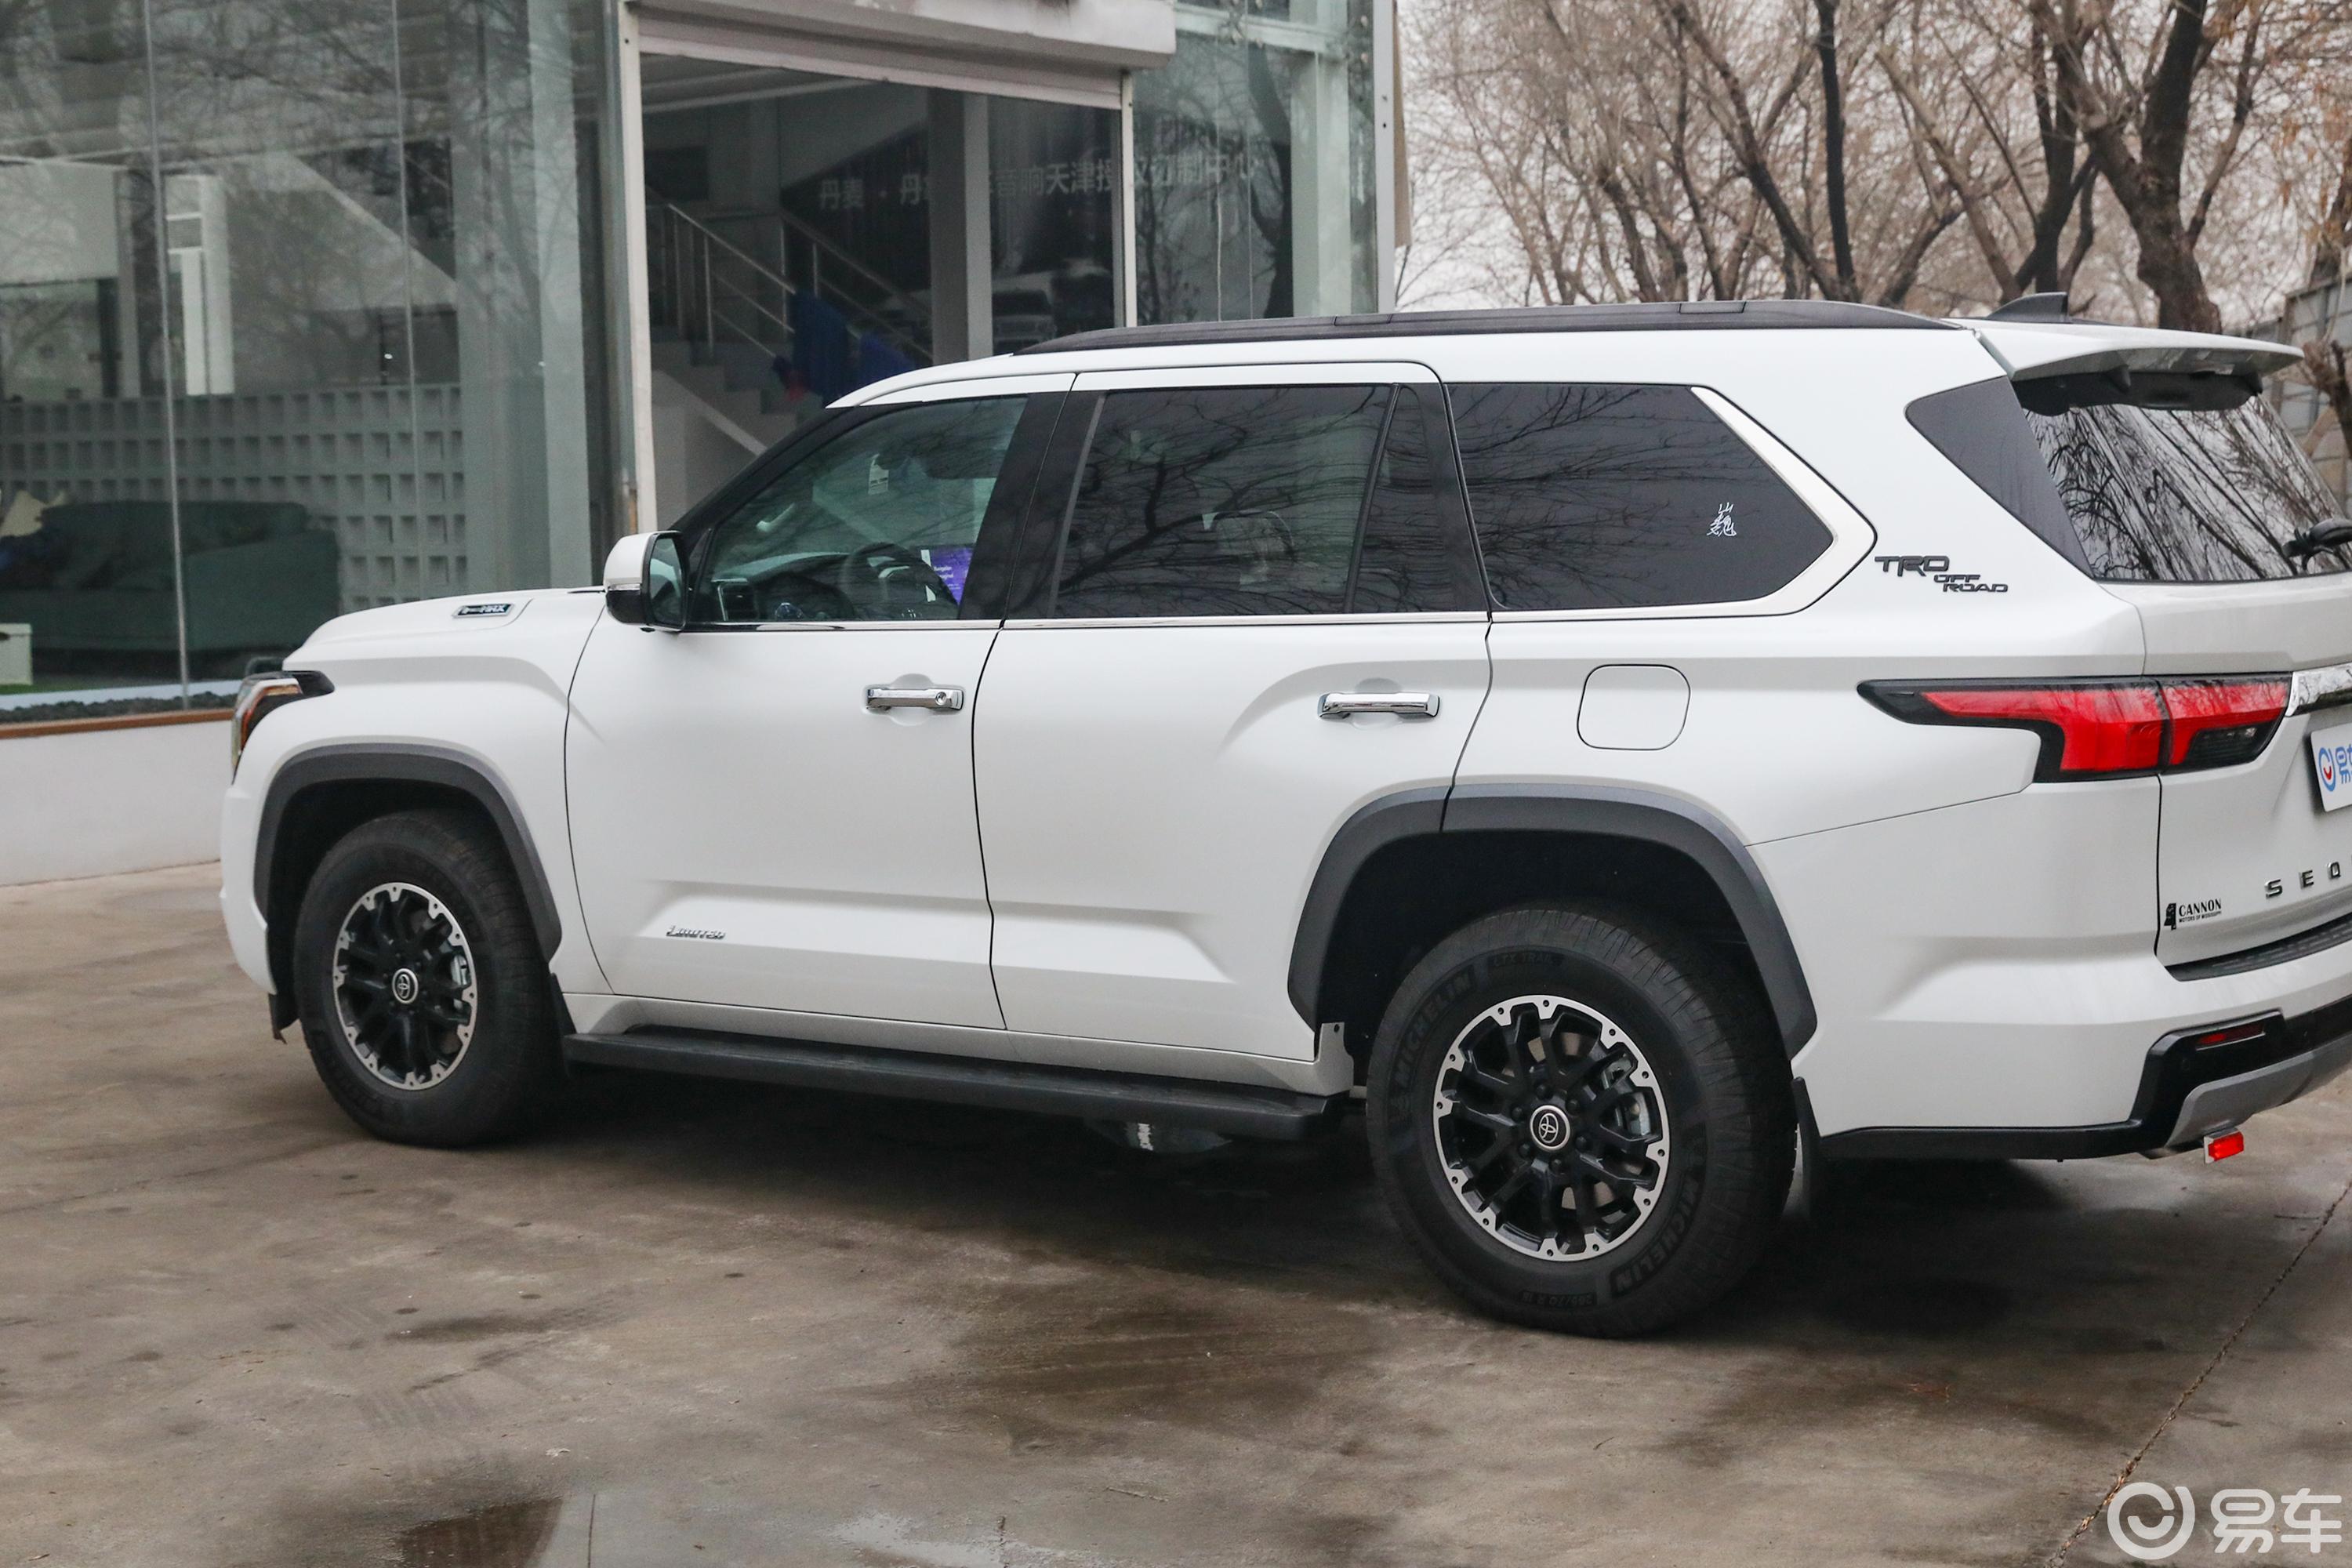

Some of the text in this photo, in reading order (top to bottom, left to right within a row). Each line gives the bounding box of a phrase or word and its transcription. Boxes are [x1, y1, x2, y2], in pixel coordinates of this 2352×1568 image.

[1875, 555, 1950, 577] TRD
[1934, 574, 1981, 583] OFF
[1943, 583, 2009, 593] ROAD
[2264, 861, 2352, 899] SEQ
[2179, 898, 2222, 917] CANNON
[1394, 972, 1472, 1088] MICHELIN
[1615, 1174, 1700, 1293] MICHELIN
